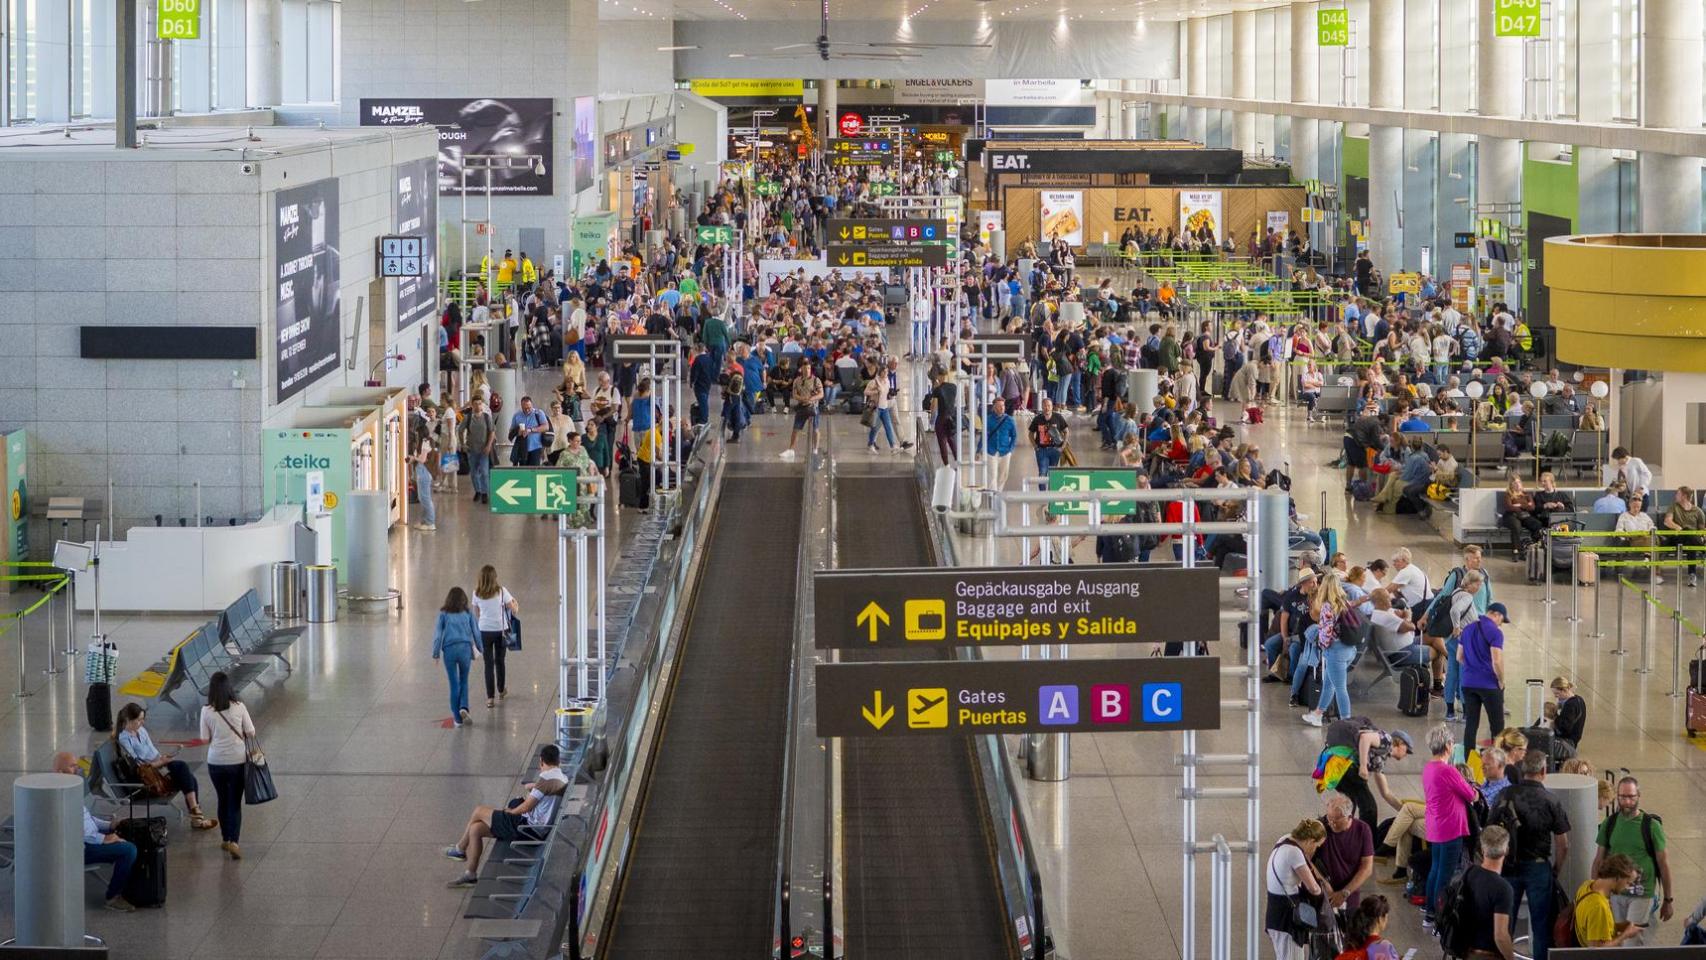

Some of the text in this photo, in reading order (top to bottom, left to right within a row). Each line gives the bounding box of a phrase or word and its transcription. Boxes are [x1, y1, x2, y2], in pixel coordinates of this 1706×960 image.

[162, 0, 195, 12] D60
[1322, 12, 1346, 25] D44
[1501, 15, 1537, 32] D47
[162, 19, 193, 35] D61
[1322, 30, 1346, 43] D45
[372, 106, 424, 116] MAMZEL
[992, 155, 1031, 169] EAT.
[1114, 207, 1154, 222] EAT.
[895, 228, 902, 237] A
[910, 228, 918, 237] B
[925, 228, 932, 237] C
[284, 454, 330, 469] teika
[955, 579, 1140, 598] Gepäckausgabe Ausgang
[956, 599, 1091, 618] Baggage and exit
[956, 617, 1137, 641] Equipajes y Salida
[958, 689, 1172, 719] Gates A B C
[958, 709, 1027, 725] Puertas
